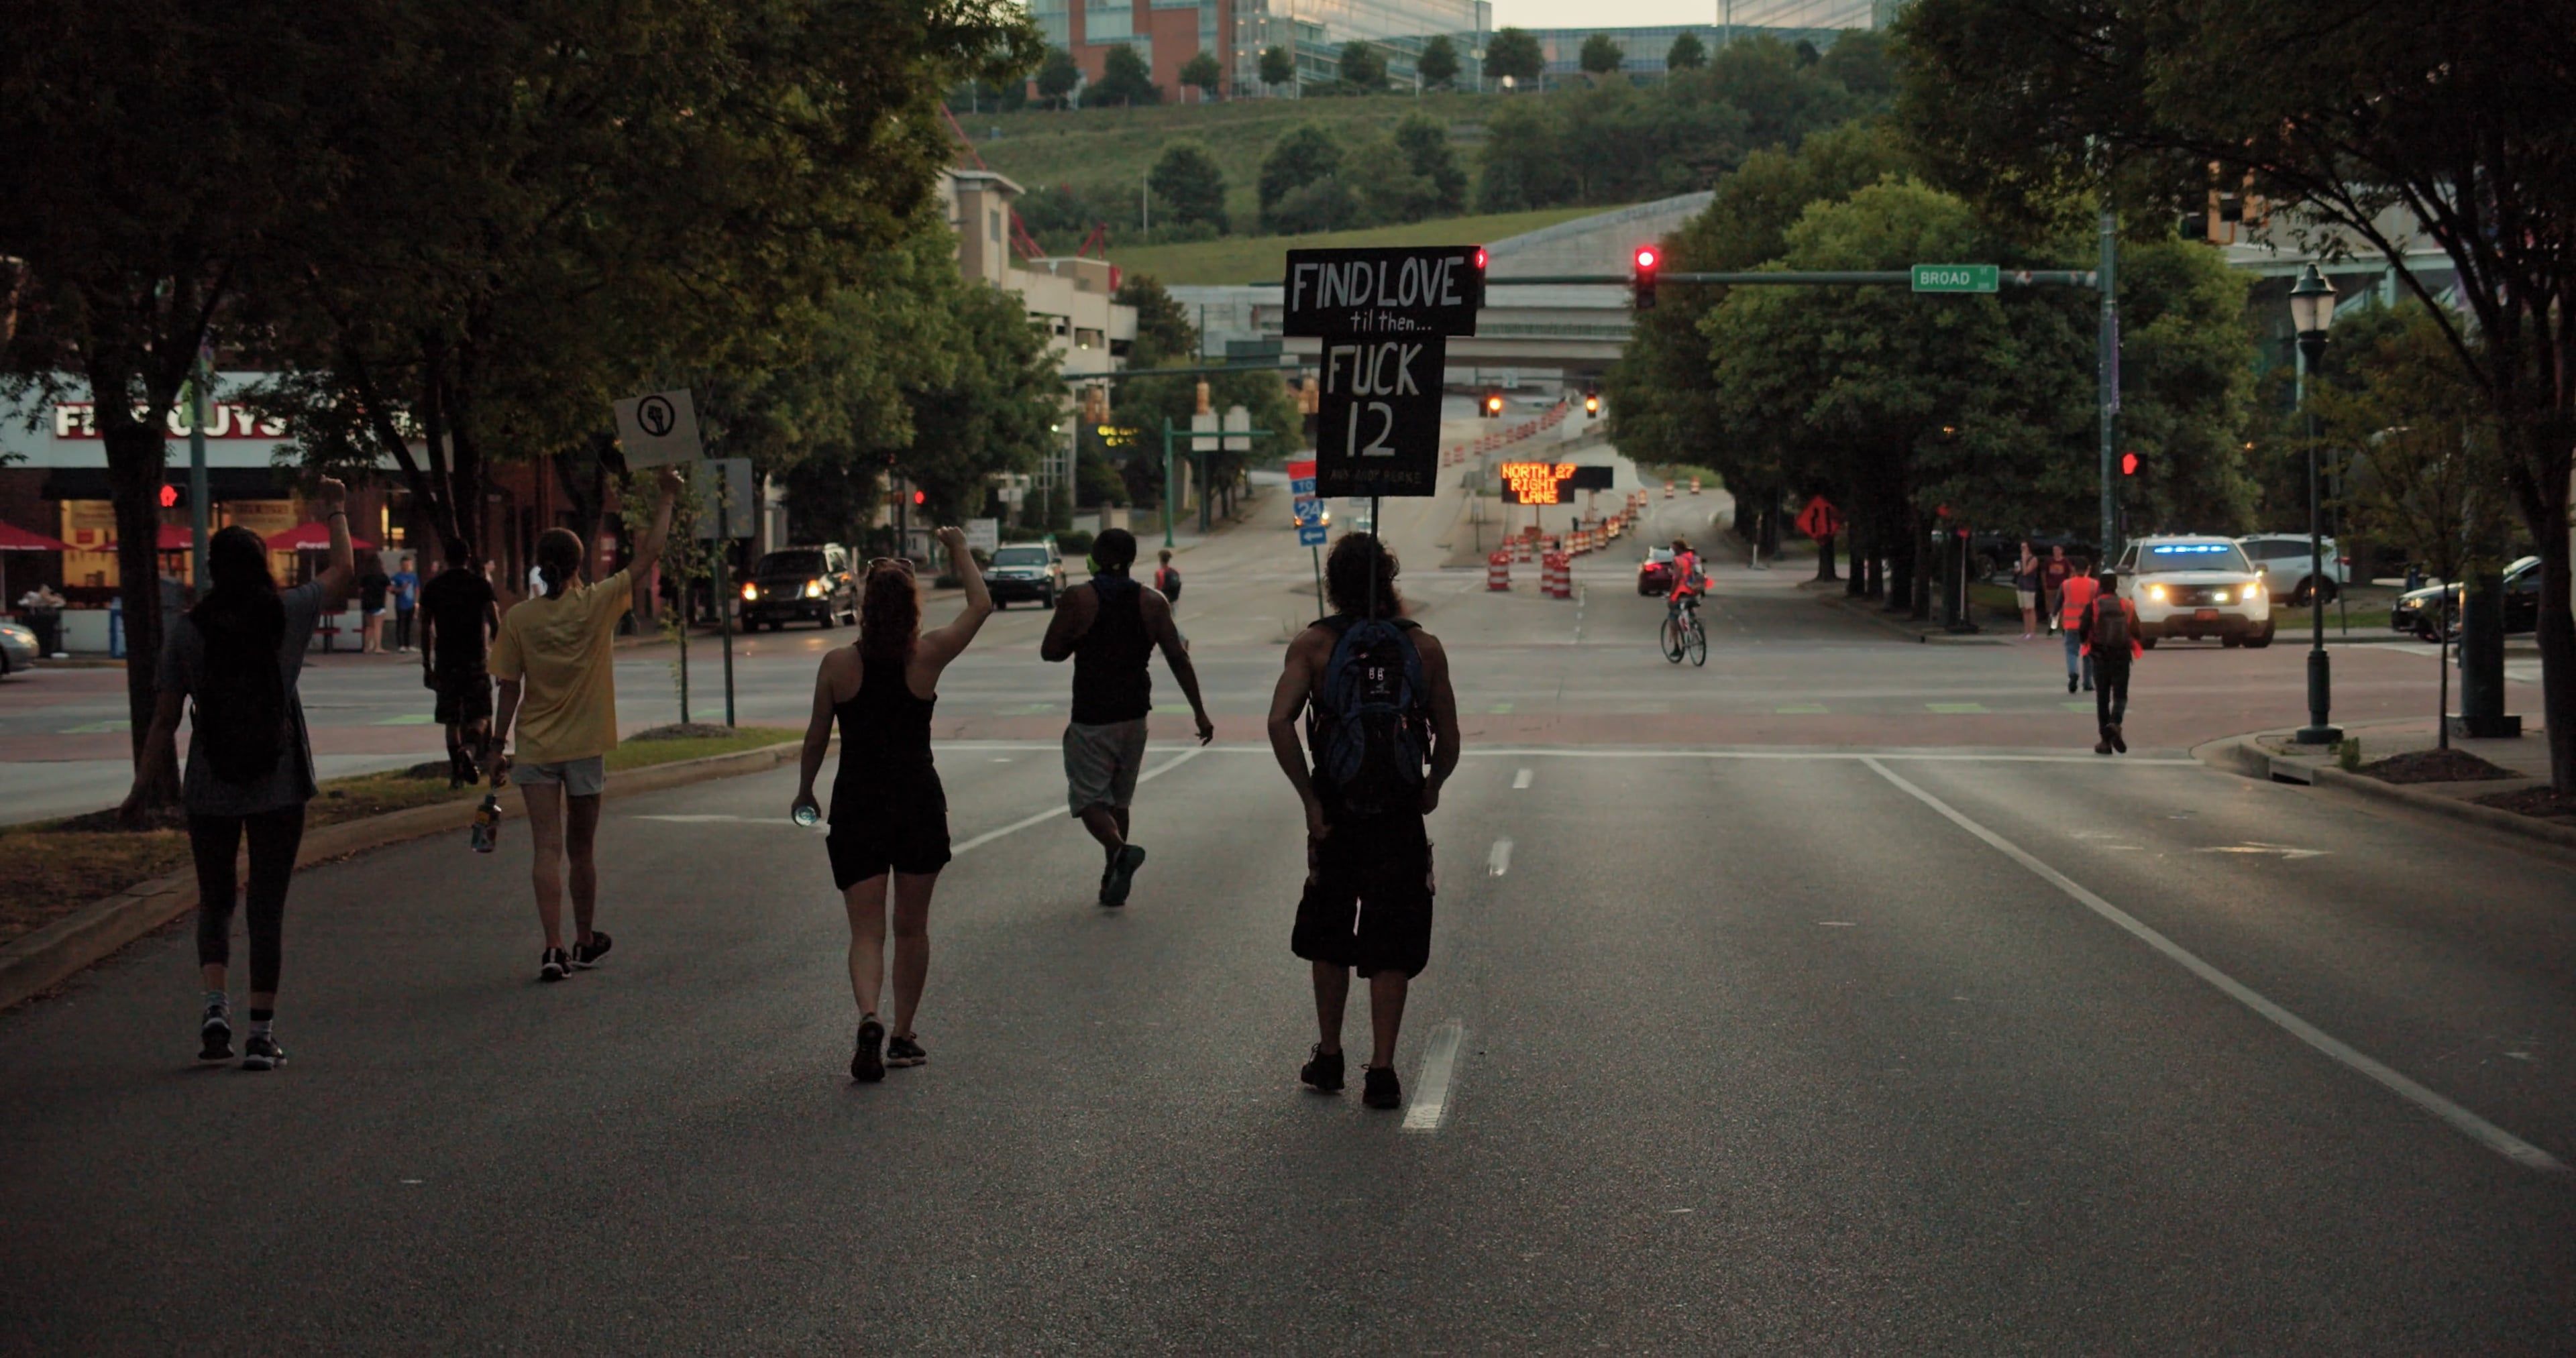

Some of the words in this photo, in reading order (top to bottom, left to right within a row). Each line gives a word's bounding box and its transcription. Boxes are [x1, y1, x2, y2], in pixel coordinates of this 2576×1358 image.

[1292, 261, 1373, 312] FIND
[1377, 256, 1464, 307] LOVE
[1920, 271, 1970, 285] BROAD
[1350, 308, 1373, 333] til
[1379, 310, 1432, 333] then...
[1327, 341, 1423, 396] FUCK
[1346, 401, 1395, 458] 12
[1501, 463, 1550, 480] NORTH
[1554, 462, 1577, 480] 27
[1298, 480, 1315, 491] TO
[1510, 476, 1558, 493] RIGHT
[1519, 490, 1559, 504] LANE
[1298, 500, 1321, 520] 24
